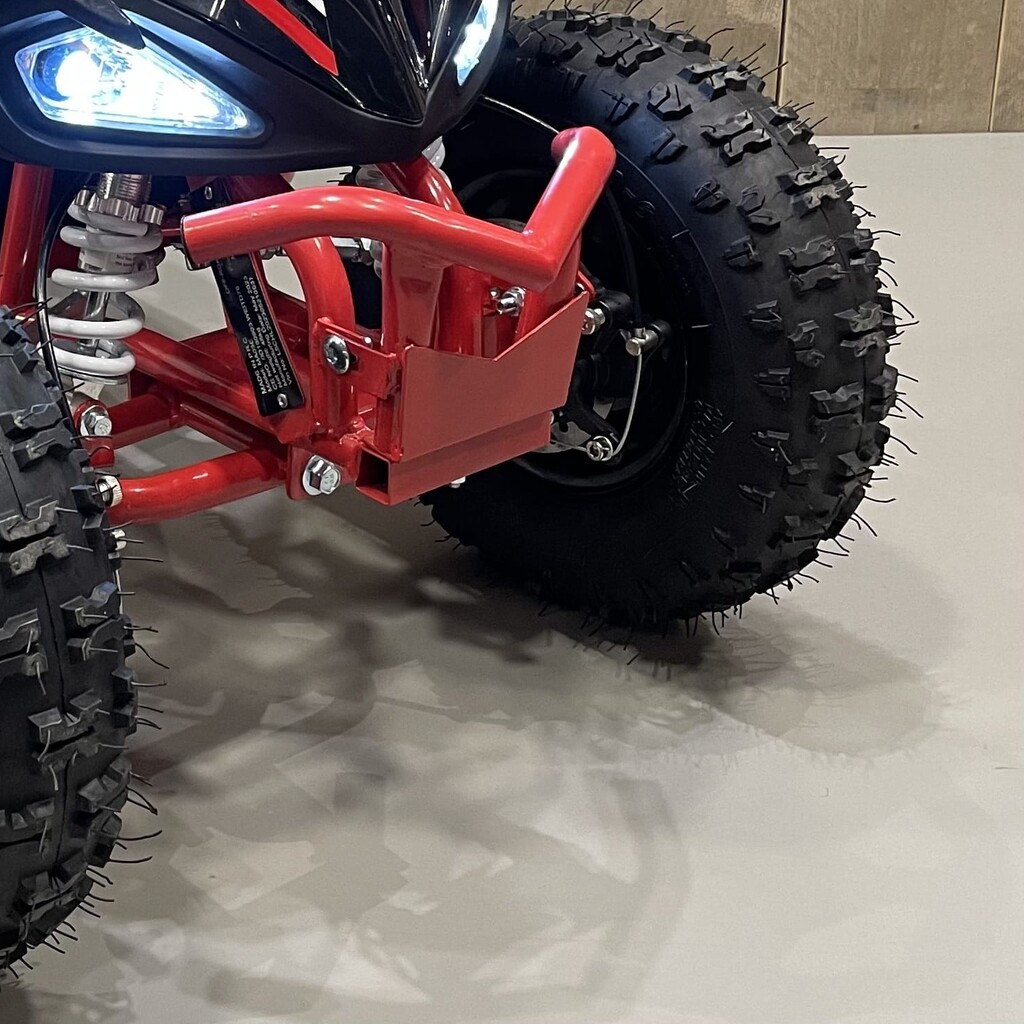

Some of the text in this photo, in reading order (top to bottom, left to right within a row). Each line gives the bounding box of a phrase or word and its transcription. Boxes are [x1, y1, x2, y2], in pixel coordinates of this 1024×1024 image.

[248, 294, 259, 312] May
[263, 333, 288, 387] Manufacturing
[253, 369, 267, 394] MADE
